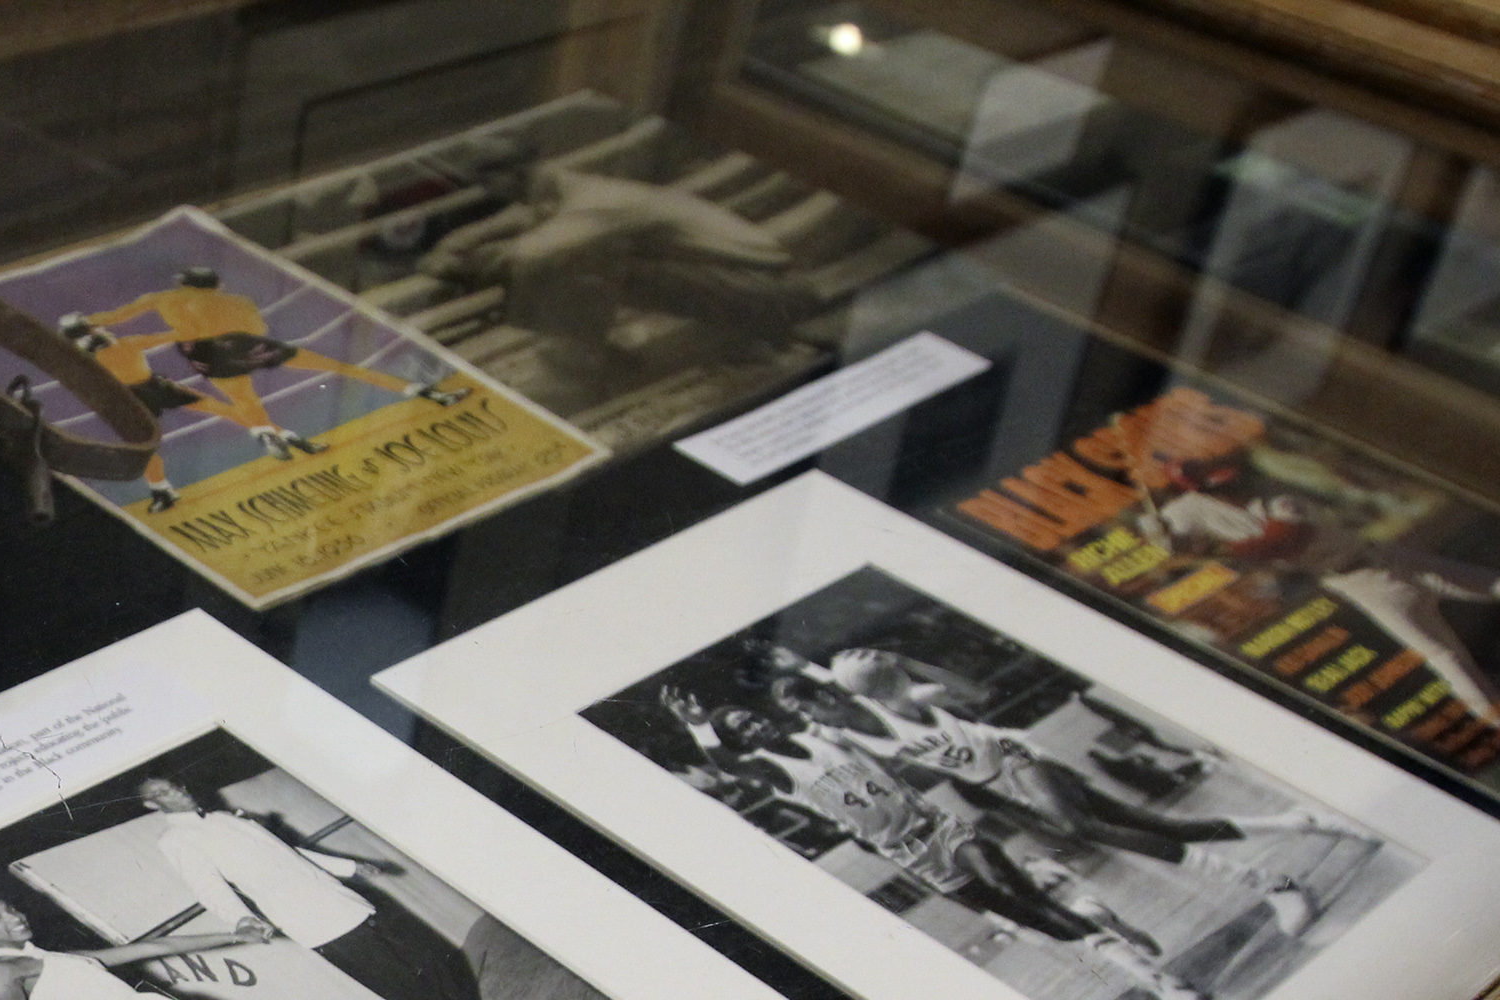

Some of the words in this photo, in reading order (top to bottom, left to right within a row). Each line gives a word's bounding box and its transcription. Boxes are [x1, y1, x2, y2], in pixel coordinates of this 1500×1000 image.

[169, 510, 251, 552] MAX
[237, 465, 373, 533] SCHMELING
[374, 434, 425, 475] JOE
[417, 398, 509, 456] LOUIS
[30, 726, 52, 742] part
[52, 721, 66, 731] of
[65, 713, 83, 724] the
[82, 692, 127, 716] National
[33, 729, 86, 753] educating
[83, 720, 101, 732] the
[3, 775, 16, 784] in
[15, 766, 33, 779] the
[161, 954, 258, 987] AND
